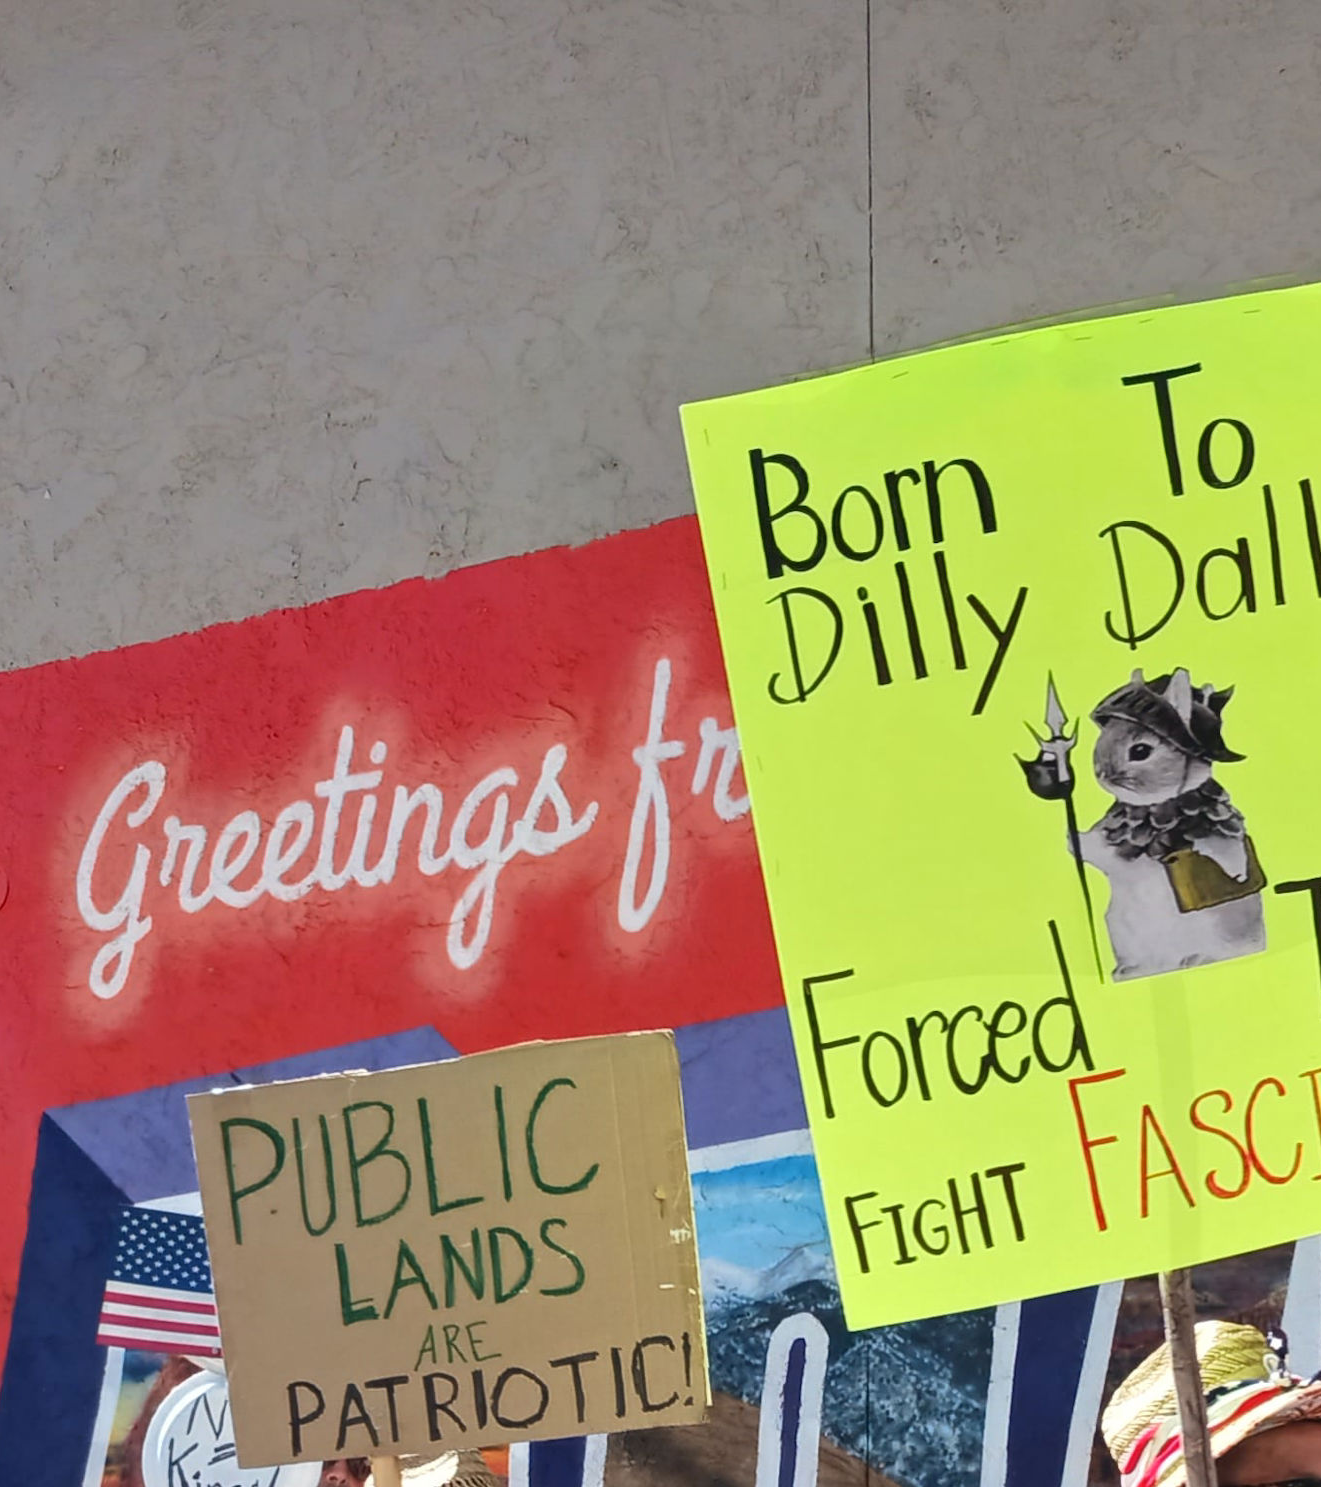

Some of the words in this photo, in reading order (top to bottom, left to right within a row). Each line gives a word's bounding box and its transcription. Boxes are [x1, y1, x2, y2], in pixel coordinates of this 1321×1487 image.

[748, 448, 998, 581] Born
[1121, 362, 1256, 496] To
[767, 551, 1029, 716] Dilly
[76, 725, 599, 999] Greetings
[618, 658, 751, 933] fr
[802, 919, 1095, 1120] Forced
[220, 1077, 600, 1246] PUBLIC
[844, 1162, 1030, 1274] FIGHT
[334, 1218, 586, 1327] LANDS
[186, 1392, 229, 1441] N
[286, 1332, 695, 1457] PATRIOTIC!
[414, 1321, 502, 1371] ARE
